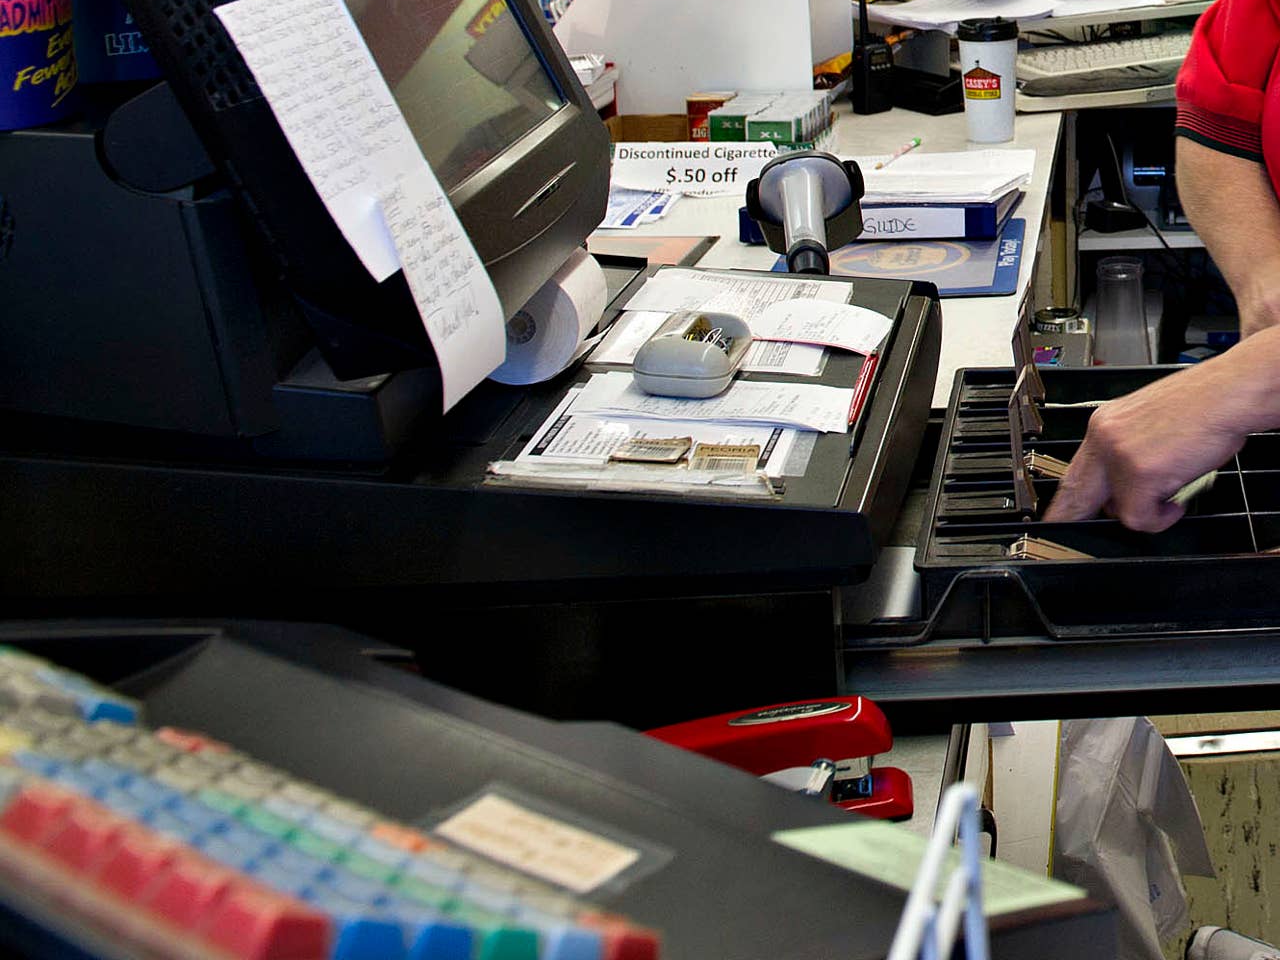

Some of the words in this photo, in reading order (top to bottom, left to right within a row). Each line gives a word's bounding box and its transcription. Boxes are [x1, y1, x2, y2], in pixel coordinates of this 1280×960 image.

[965, 78, 998, 90] CASEY'S
[619, 147, 710, 160] Discontinued
[666, 167, 706, 185] $.50
[711, 167, 738, 183] off
